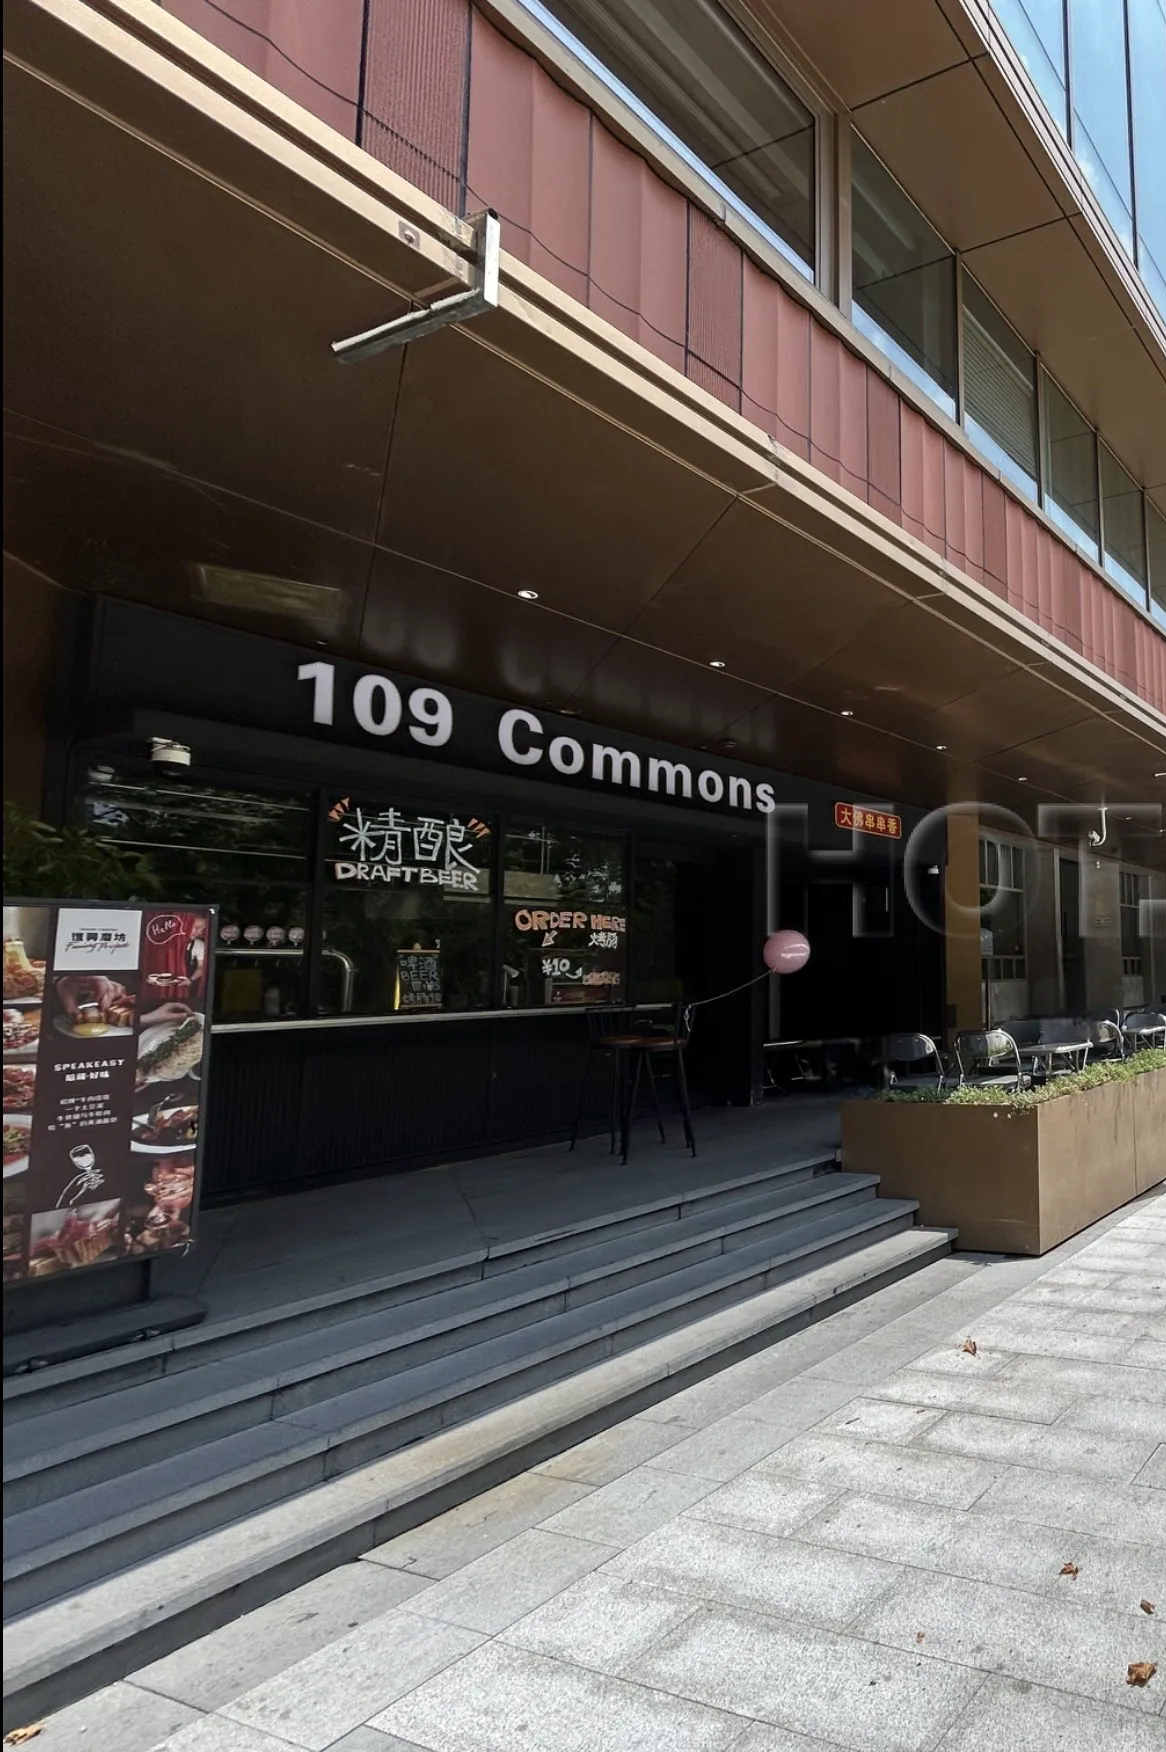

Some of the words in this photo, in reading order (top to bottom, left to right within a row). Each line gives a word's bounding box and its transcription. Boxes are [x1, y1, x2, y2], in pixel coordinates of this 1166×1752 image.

[298, 661, 453, 747] 109
[498, 708, 776, 813] Commons
[339, 807, 480, 874] 精酿
[515, 909, 588, 931] ORDER
[590, 914, 626, 932] HERE
[400, 970, 439, 982] BEER
[541, 958, 571, 976] ¥10
[54, 1059, 125, 1072] SPEAKEASY
